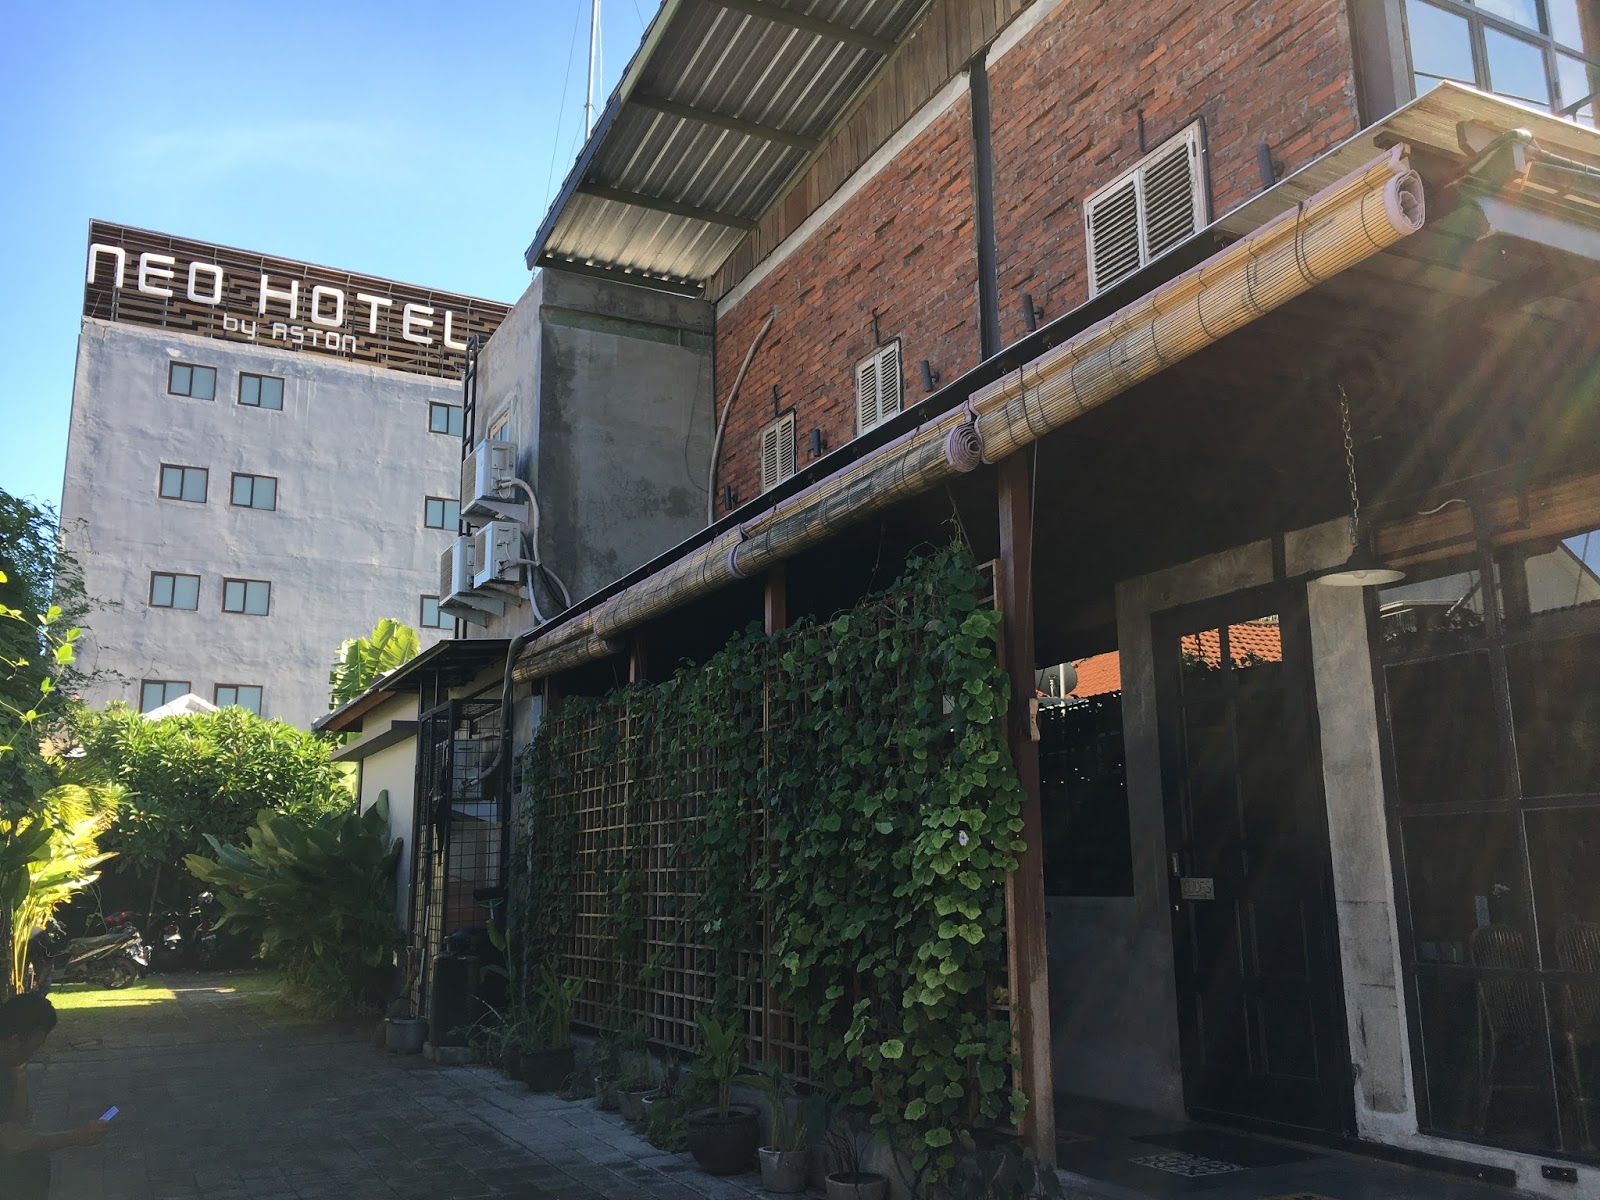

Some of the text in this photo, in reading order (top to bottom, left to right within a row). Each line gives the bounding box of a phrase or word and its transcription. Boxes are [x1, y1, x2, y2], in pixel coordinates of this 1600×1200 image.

[87, 243, 468, 351] NEO HOTEL
[223, 312, 357, 352] by ASTON
